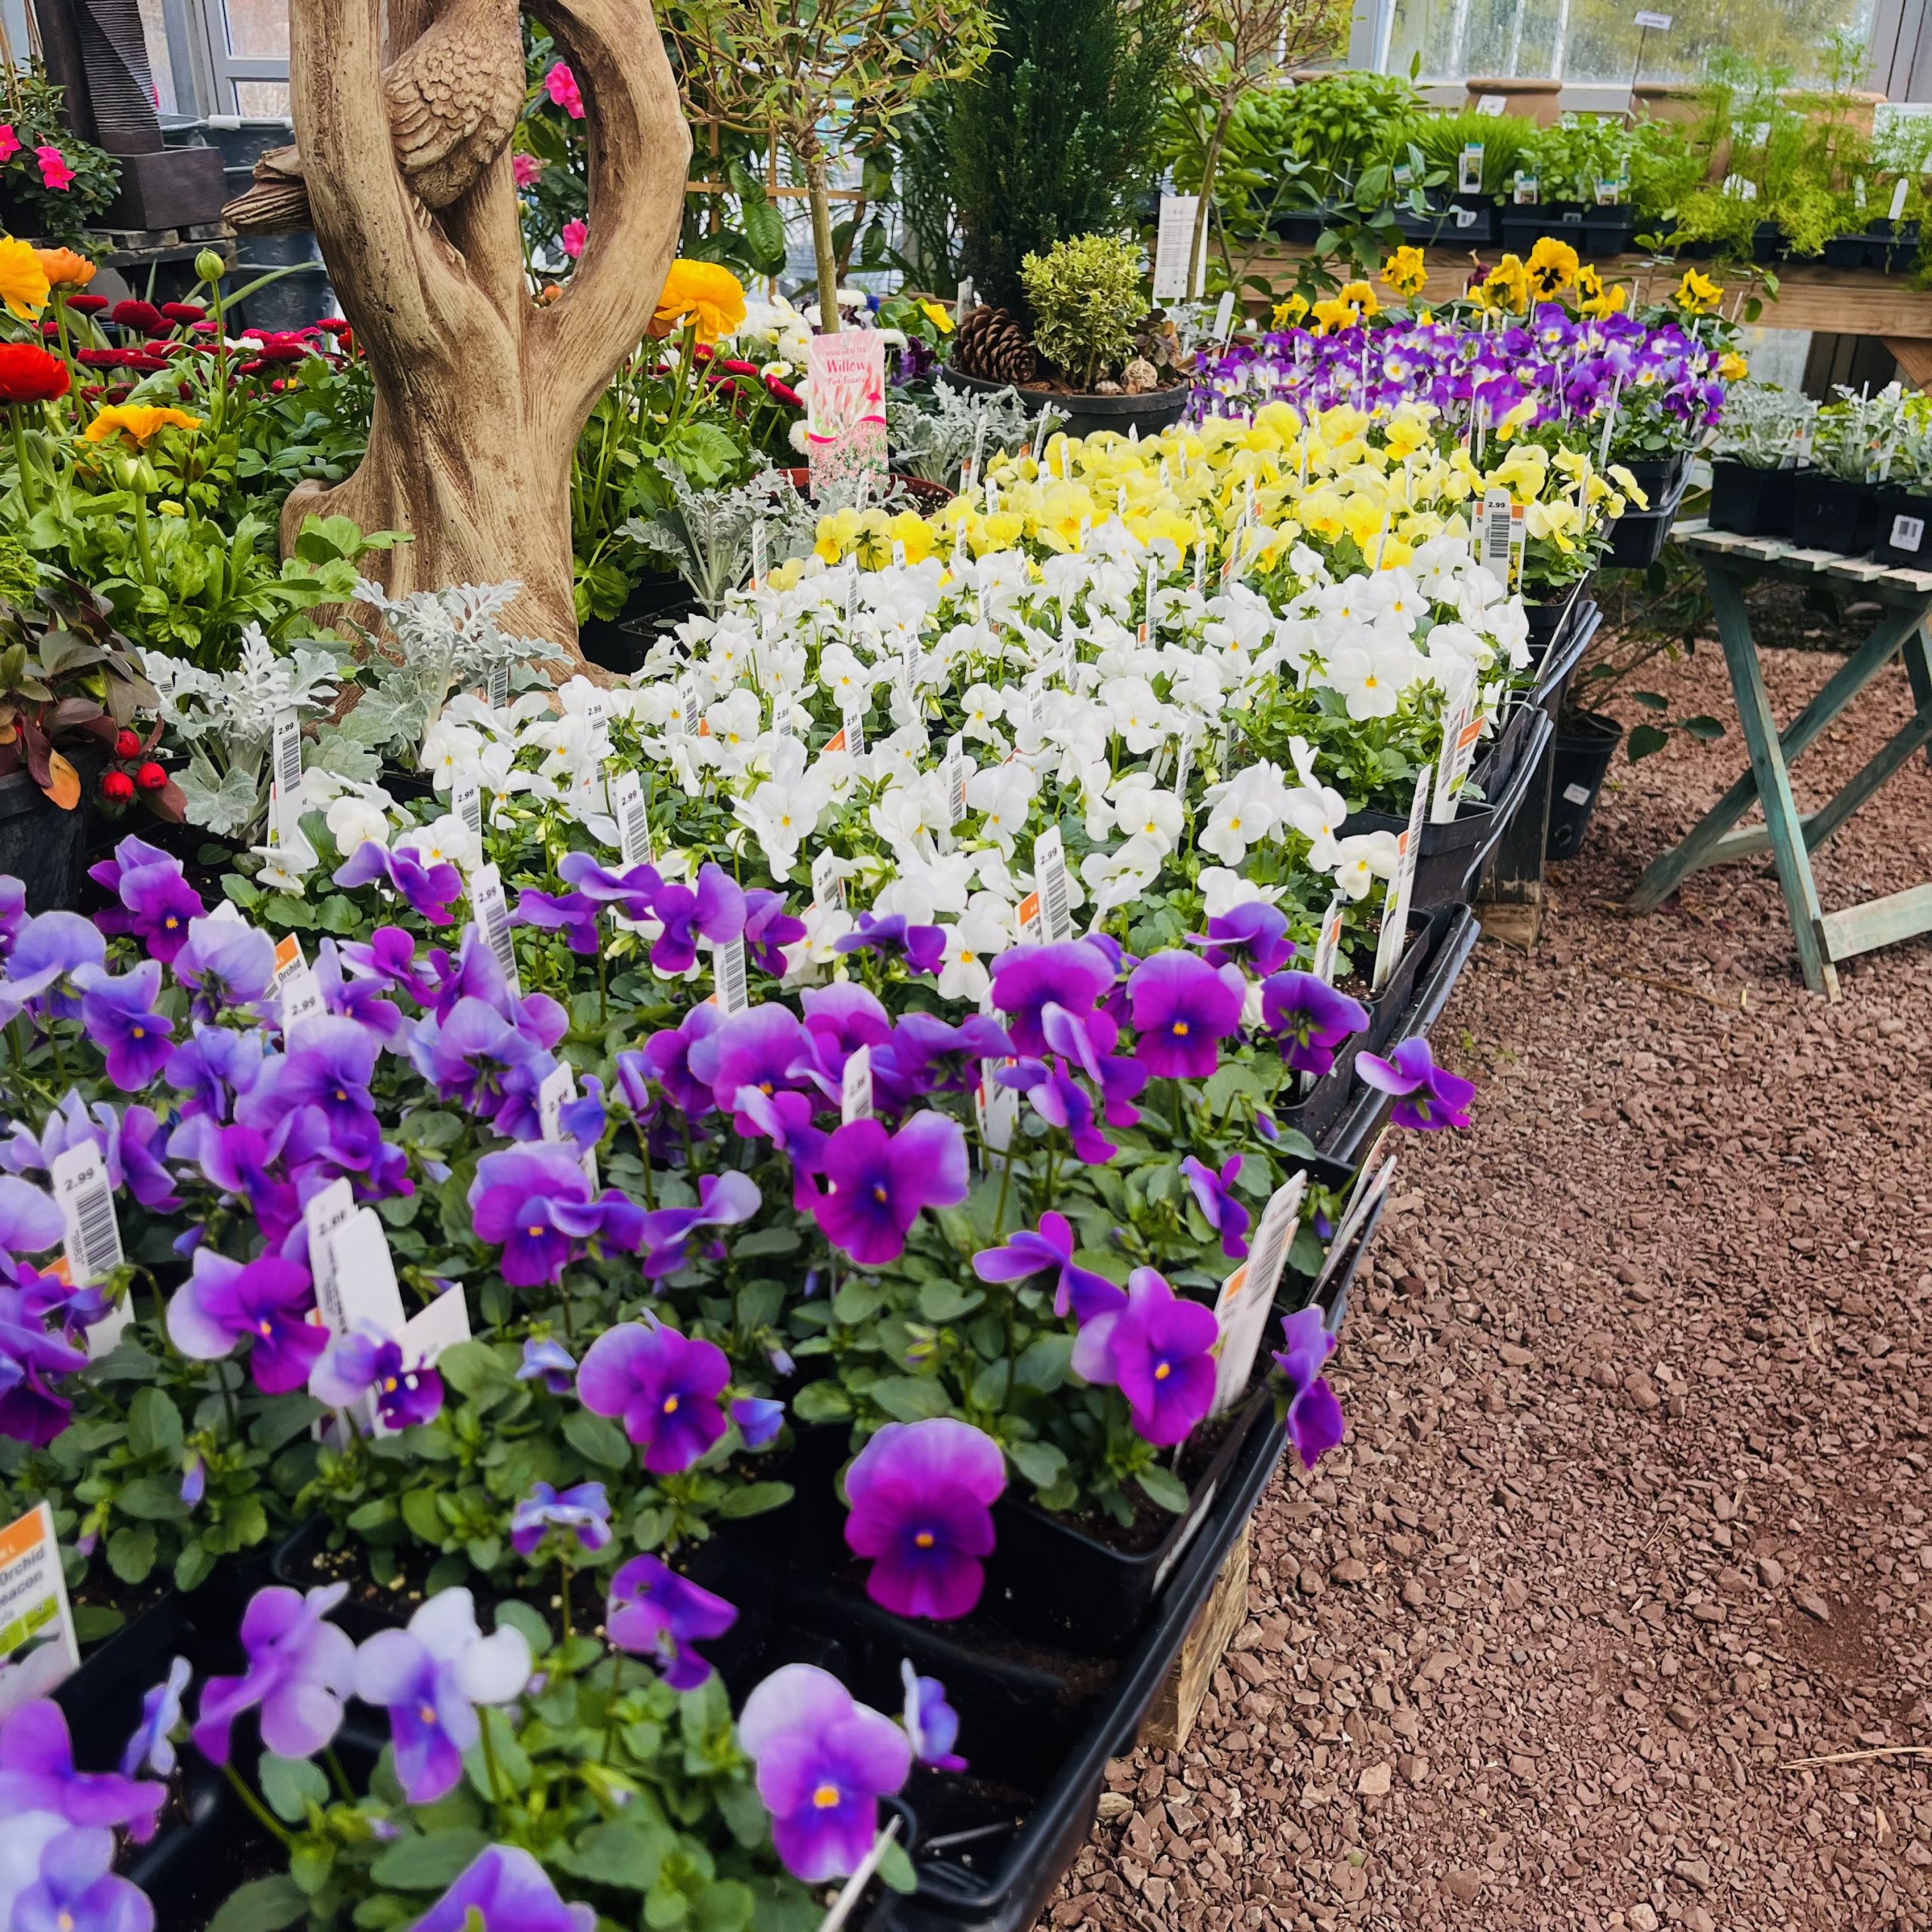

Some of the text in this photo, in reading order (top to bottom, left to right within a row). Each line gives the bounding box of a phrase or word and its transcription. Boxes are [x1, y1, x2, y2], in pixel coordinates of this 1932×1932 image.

[827, 358, 865, 374] Willow
[1030, 688, 1041, 701] 2.99
[587, 705, 602, 716] 2.99
[777, 708, 789, 720] 2.99
[847, 713, 857, 726] 2.99
[278, 721, 294, 736] 2.99
[457, 788, 475, 803] 2.99
[621, 789, 637, 806] 2.99
[1040, 847, 1057, 866] 2.99
[818, 867, 832, 888] 2.99
[478, 886, 497, 903] 2.99
[278, 958, 301, 982] Orchid
[291, 996, 315, 1017] 2.99
[64, 1168, 95, 1192] 2.99
[0, 1570, 43, 1607] eacon
